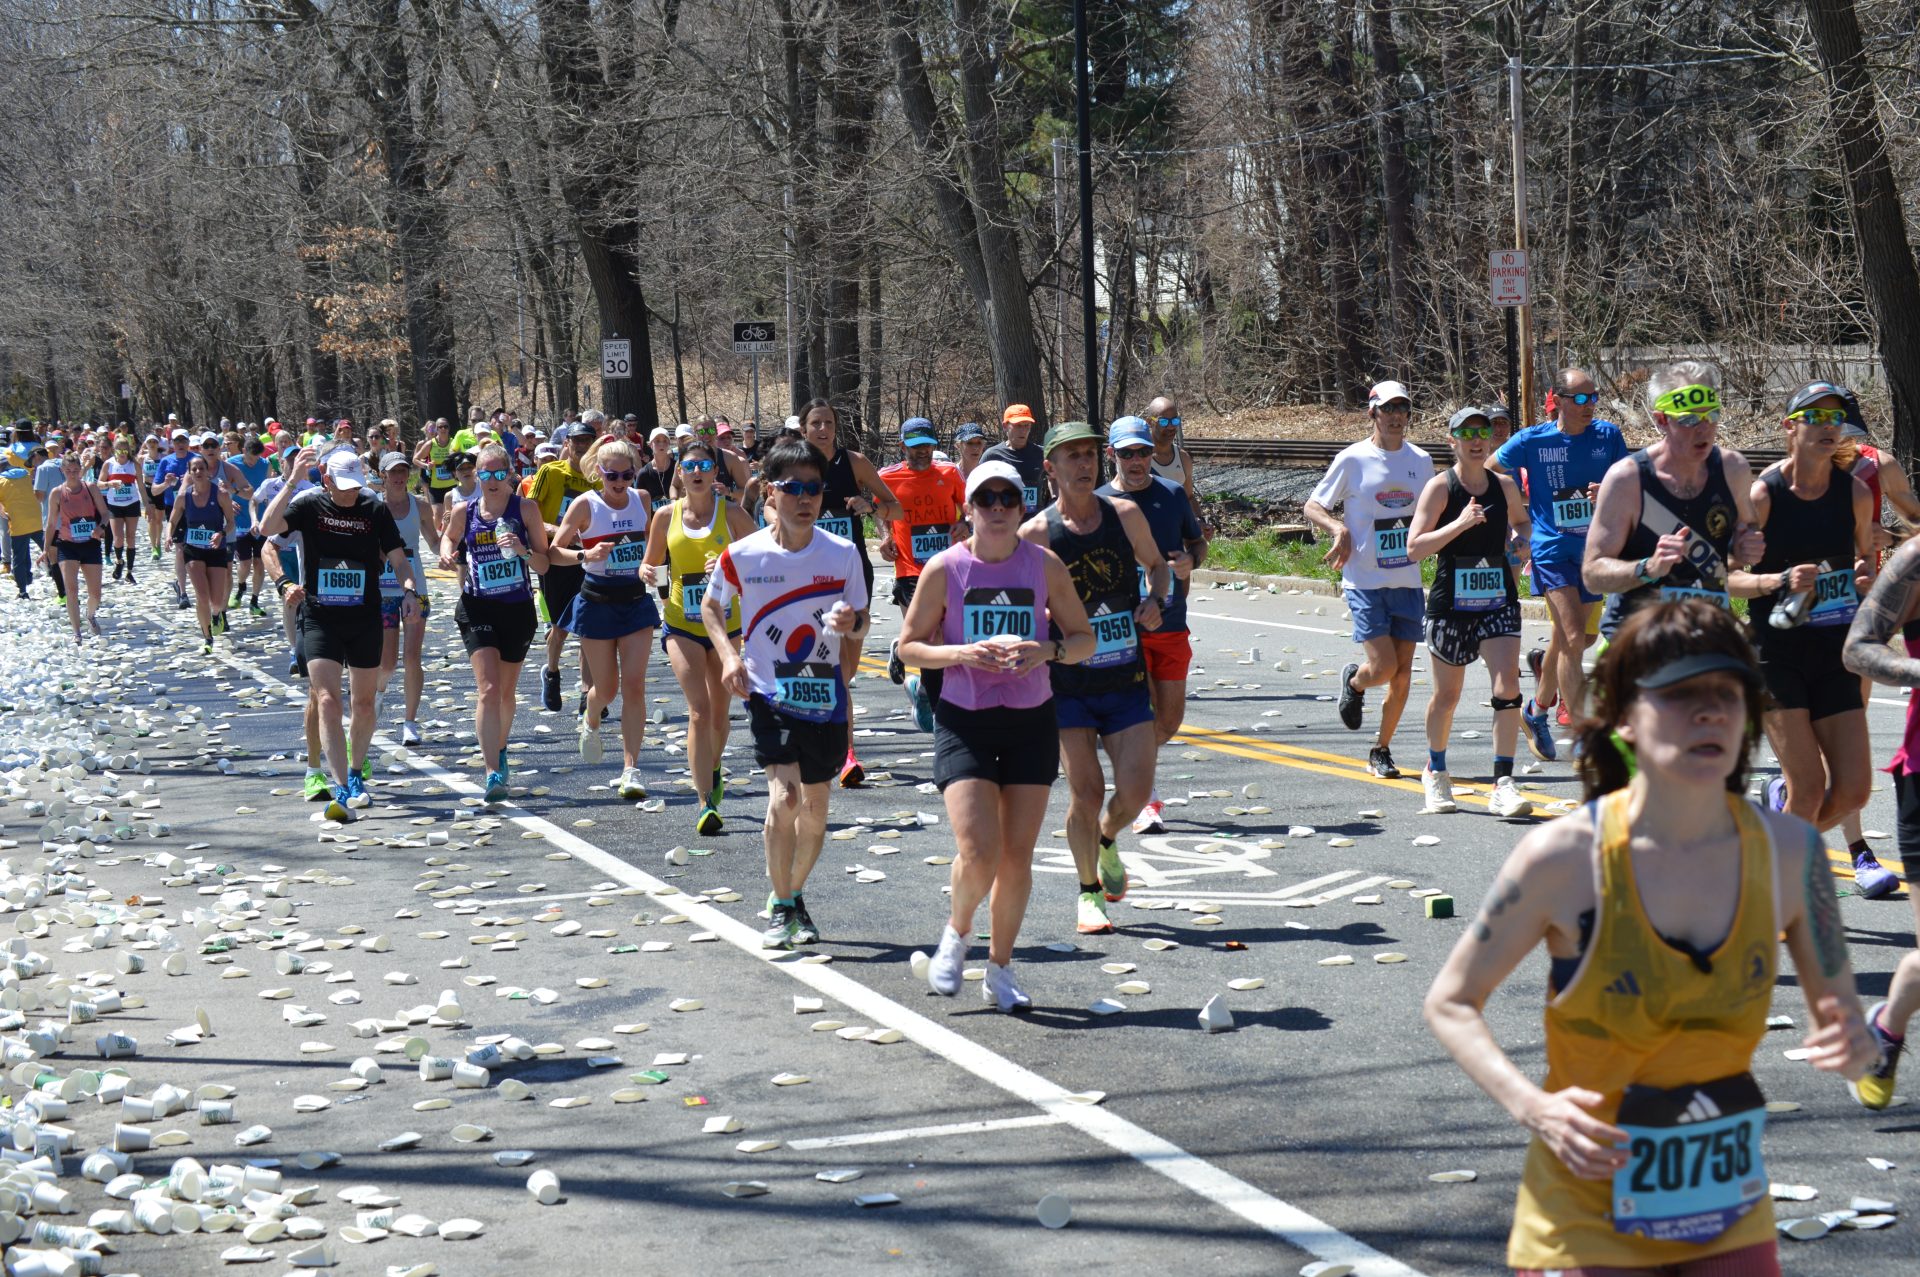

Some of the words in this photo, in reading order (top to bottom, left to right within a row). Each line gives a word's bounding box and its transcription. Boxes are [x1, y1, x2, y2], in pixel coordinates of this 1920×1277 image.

[1501, 254, 1515, 265] NO
[1492, 266, 1525, 278] PARKING
[1502, 286, 1516, 294] TIME
[736, 342, 751, 352] BIKE
[756, 342, 774, 352] LANE
[605, 359, 629, 374] 30
[1538, 446, 1569, 463] FRANCE
[1557, 464, 1566, 489] BOSTON
[914, 495, 934, 506] GO
[1023, 489, 1035, 501] 73
[904, 505, 949, 523] JAMIE
[612, 519, 633, 528] FIFE
[914, 532, 950, 553] 20404
[611, 543, 644, 563] 18539
[322, 571, 361, 589] 16680
[481, 560, 517, 582] 19267
[1460, 571, 1501, 591] 19053
[1814, 573, 1851, 603] 092
[970, 610, 1032, 637] 16700
[783, 680, 831, 704] 16955
[1629, 1120, 1753, 1194] 20758
